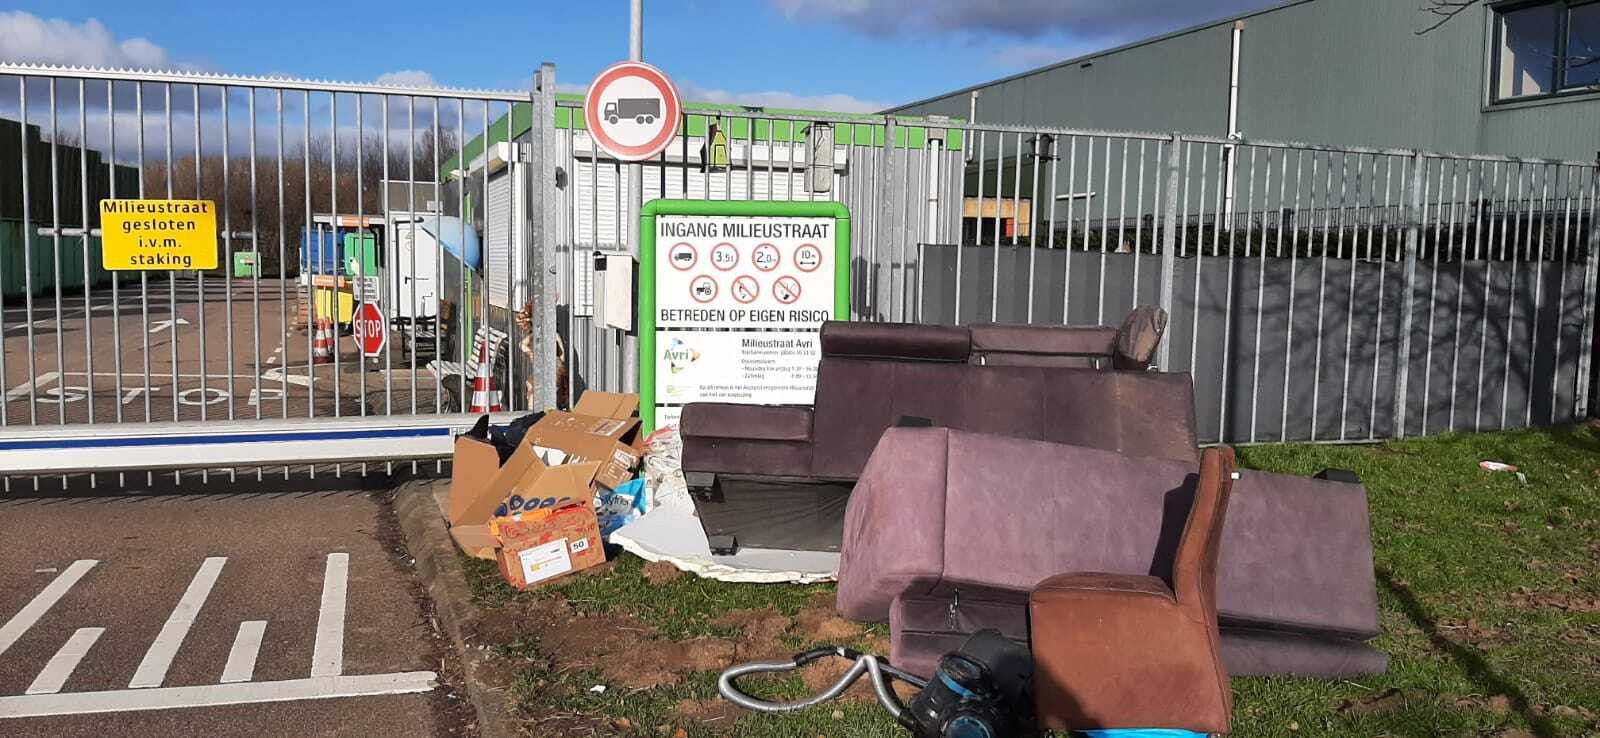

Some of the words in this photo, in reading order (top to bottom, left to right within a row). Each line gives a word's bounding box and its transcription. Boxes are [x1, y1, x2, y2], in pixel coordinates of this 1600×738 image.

[103, 201, 208, 214] Milieustraat
[122, 219, 196, 233] gesloten
[660, 222, 718, 238] INGANG
[723, 223, 830, 239] MILIEUSTRAAT
[139, 236, 182, 248] i.v.m.
[130, 252, 192, 267] staking
[660, 309, 725, 322] BETREDEN
[729, 310, 746, 322] OP
[749, 310, 785, 323] EIGEN
[789, 310, 829, 323] RISICO
[355, 319, 381, 338] STOP
[741, 338, 793, 348] Milieustraat
[796, 338, 813, 349] Avri
[663, 348, 689, 361] Avri
[36, 386, 289, 406] STOP
[573, 540, 585, 550] 50
